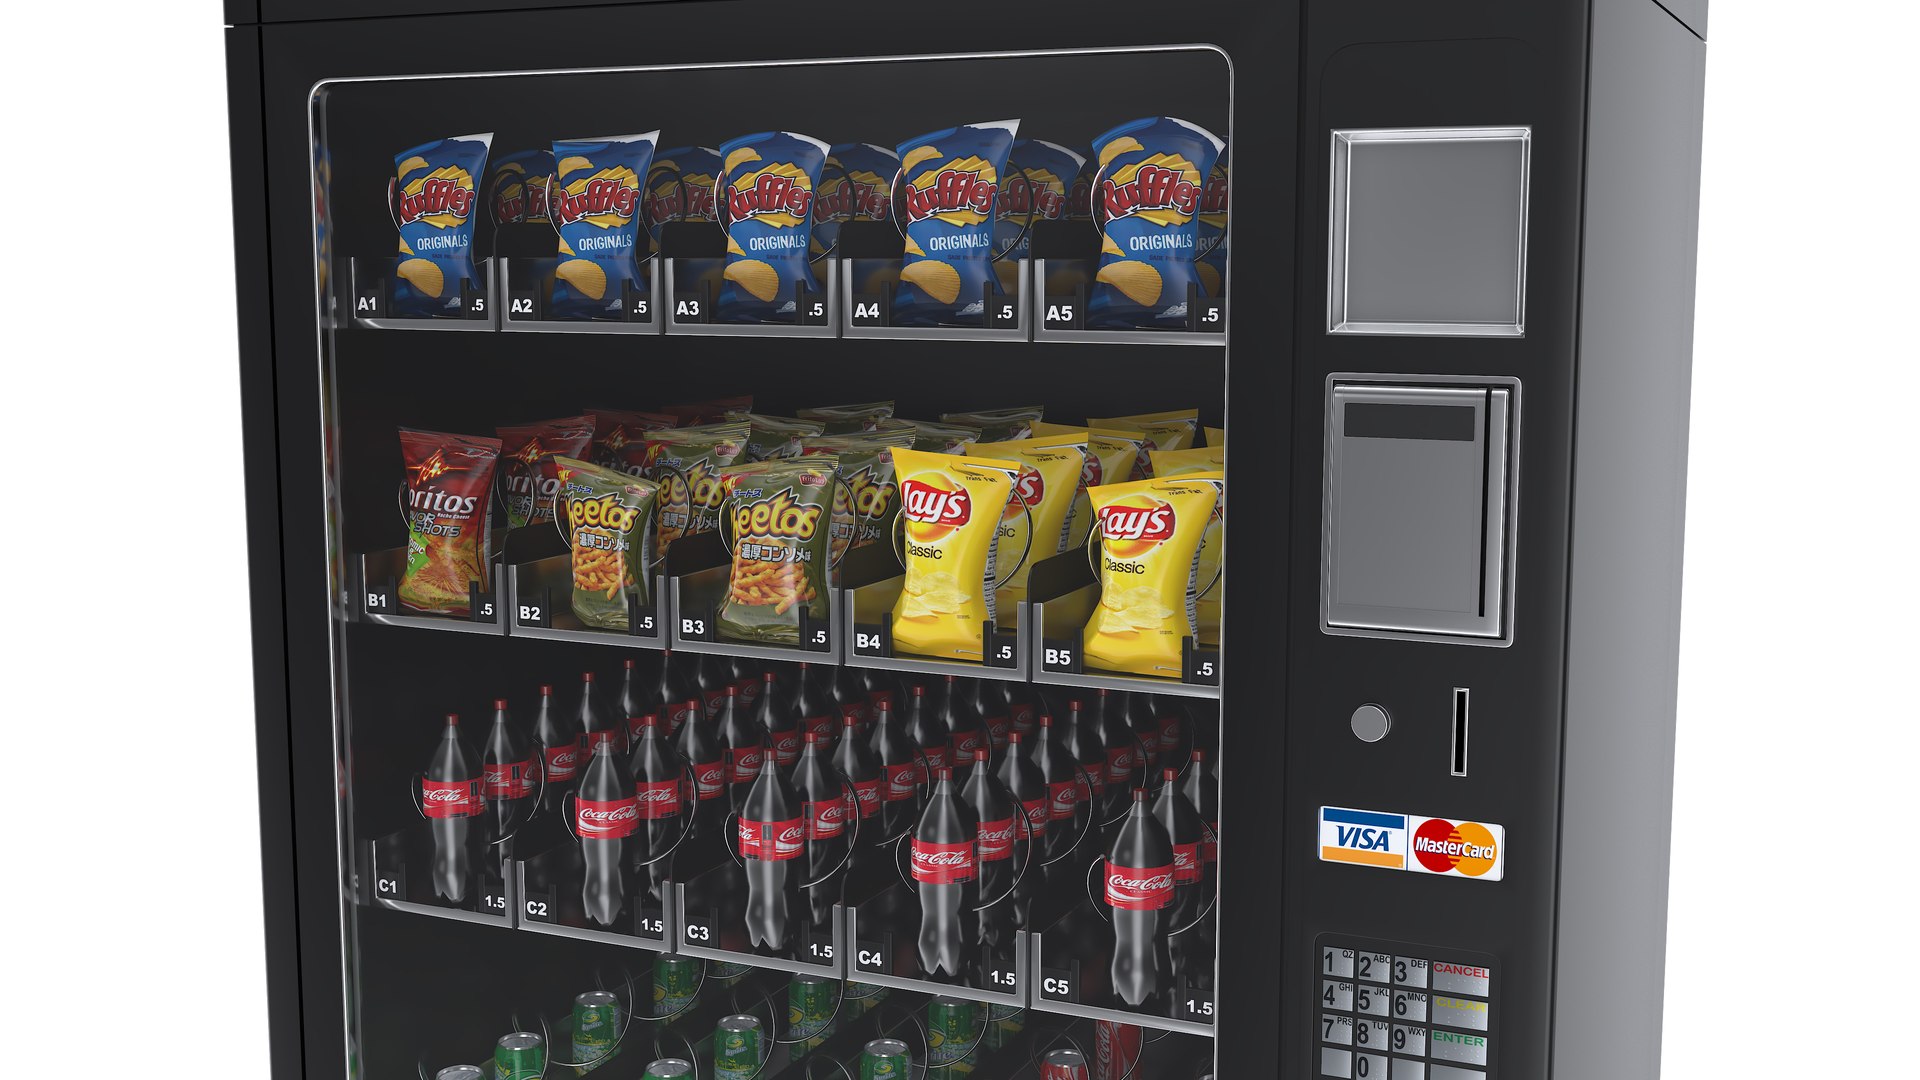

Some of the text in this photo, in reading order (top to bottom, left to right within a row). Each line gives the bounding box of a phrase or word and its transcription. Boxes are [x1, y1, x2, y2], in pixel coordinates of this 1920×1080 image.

[416, 234, 468, 251] ORIGINALS
[578, 233, 632, 251] ORIGINALS
[749, 234, 806, 251] ORIGINALS
[929, 232, 990, 252] ORIGINALS
[1129, 232, 1193, 251] ORIGINALS
[357, 296, 376, 311] A1
[471, 298, 484, 311] .5
[510, 298, 533, 313] A2
[633, 300, 647, 314] .5
[676, 300, 700, 316] A3
[808, 302, 824, 317] .5
[854, 302, 880, 318] A4
[997, 305, 1013, 319] .5
[1045, 305, 1073, 322] A5
[1202, 307, 1219, 322] .5
[414, 522, 462, 538] SHOTS
[1104, 557, 1145, 575] Classic
[368, 593, 386, 608] B1
[480, 603, 493, 616] .5
[519, 605, 541, 621] B2
[639, 616, 653, 629] .5
[682, 618, 705, 635] B3
[811, 630, 826, 644] .5
[856, 633, 881, 650] B4
[996, 645, 1012, 659] .5
[1045, 648, 1071, 666] B5
[1196, 662, 1213, 676] .5
[1336, 825, 1389, 852] VISA
[1415, 837, 1495, 860] MasterCard
[378, 878, 397, 894] C1
[485, 894, 505, 909] 1.5
[526, 900, 547, 917] C2
[641, 918, 663, 933] 1.5
[687, 924, 710, 941] C3
[810, 943, 833, 958] 1.5
[858, 950, 883, 967] C4
[1342, 950, 1354, 959] QZ
[1324, 951, 1333, 972] 1
[1359, 956, 1372, 978] 2
[990, 970, 1016, 986] 1.5
[1395, 961, 1407, 982] 3
[1433, 963, 1489, 979] CANCEL
[1043, 977, 1069, 995] C5
[1338, 983, 1354, 992] GHI
[1373, 987, 1390, 997] JKL
[1323, 985, 1335, 1006] 4
[1358, 989, 1371, 1011] 5
[1186, 999, 1213, 1016] 1.5
[1394, 995, 1408, 1016] 6
[1436, 997, 1486, 1013] CLEAR
[1323, 1018, 1335, 1039] 7
[1336, 1017, 1353, 1026] PRS
[1371, 1021, 1389, 1031] TUV
[1357, 1022, 1369, 1044] 8
[1393, 1028, 1406, 1050] 9
[1407, 1026, 1426, 1037] WXY
[1433, 1031, 1485, 1047] ENTER
[1357, 1056, 1369, 1078] 0
